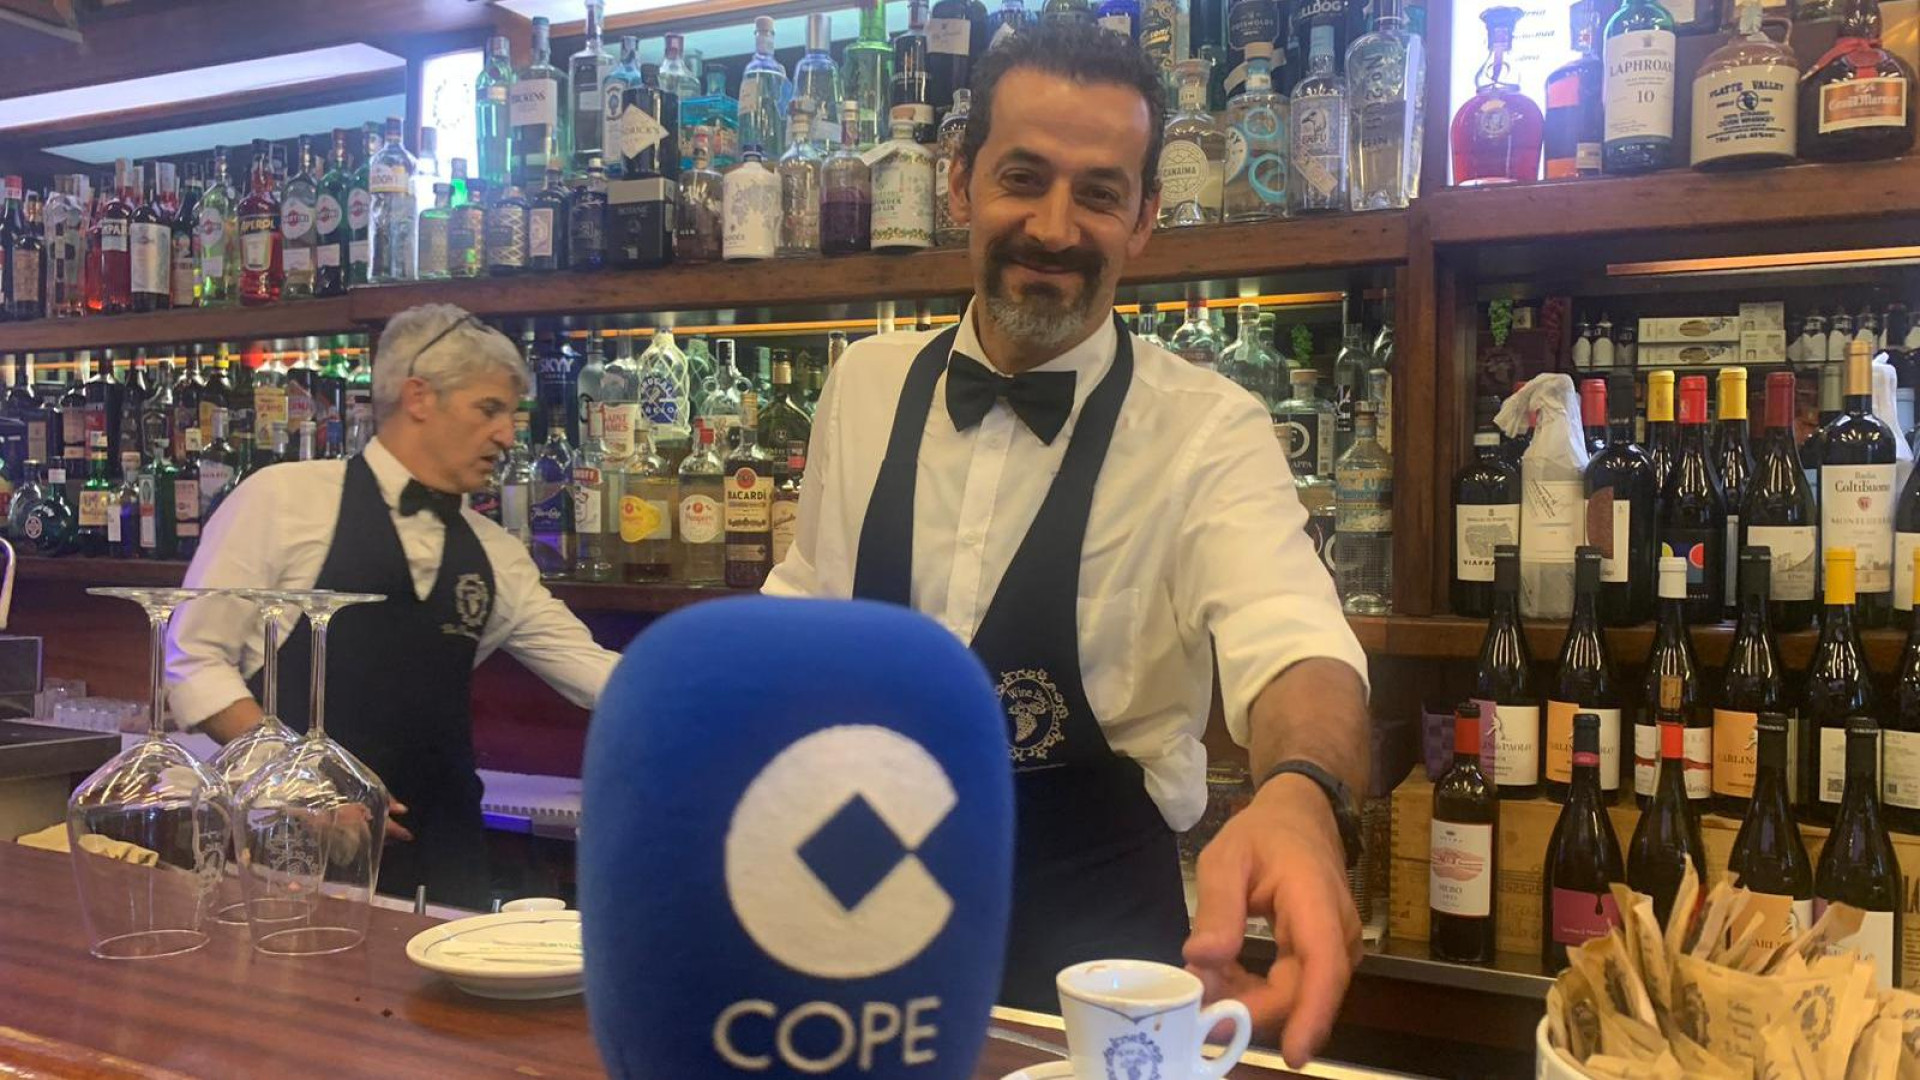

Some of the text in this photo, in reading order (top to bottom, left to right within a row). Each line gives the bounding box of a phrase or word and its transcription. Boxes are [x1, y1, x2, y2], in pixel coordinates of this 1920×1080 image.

[1752, 80, 1784, 91] VALLEY
[1637, 90, 1655, 104] 10
[541, 356, 574, 372] SKYY
[712, 996, 942, 1075] COPE
